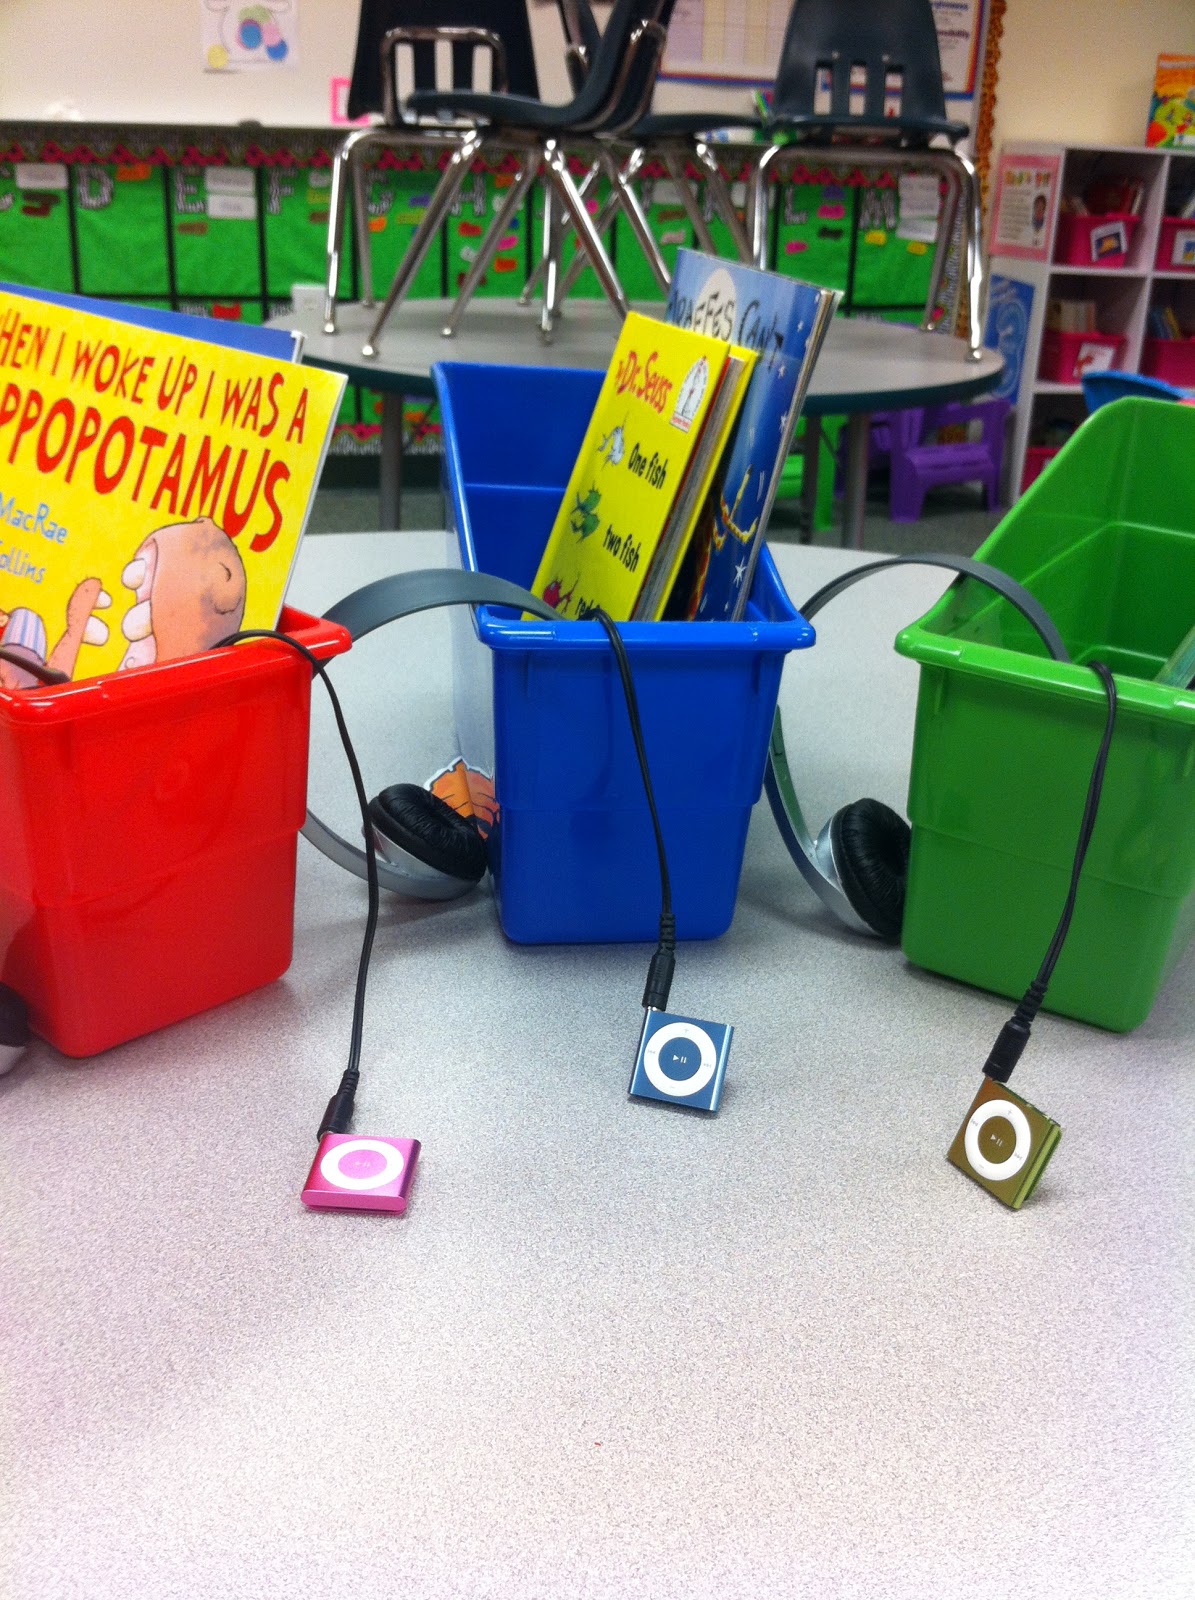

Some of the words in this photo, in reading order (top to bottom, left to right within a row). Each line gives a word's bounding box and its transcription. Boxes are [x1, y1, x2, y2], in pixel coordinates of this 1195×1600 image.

[0, 307, 50, 371] HEN
[51, 331, 66, 376] I
[70, 339, 156, 405] WOKE
[157, 355, 198, 416] UP
[199, 370, 215, 420] I
[220, 371, 286, 439] WAS
[285, 387, 309, 445] A
[643, 350, 673, 414] Seuss
[627, 442, 647, 478] One
[645, 451, 669, 490] fish
[0, 545, 46, 585] ollins
[602, 524, 622, 557] two
[618, 533, 642, 573] fish
